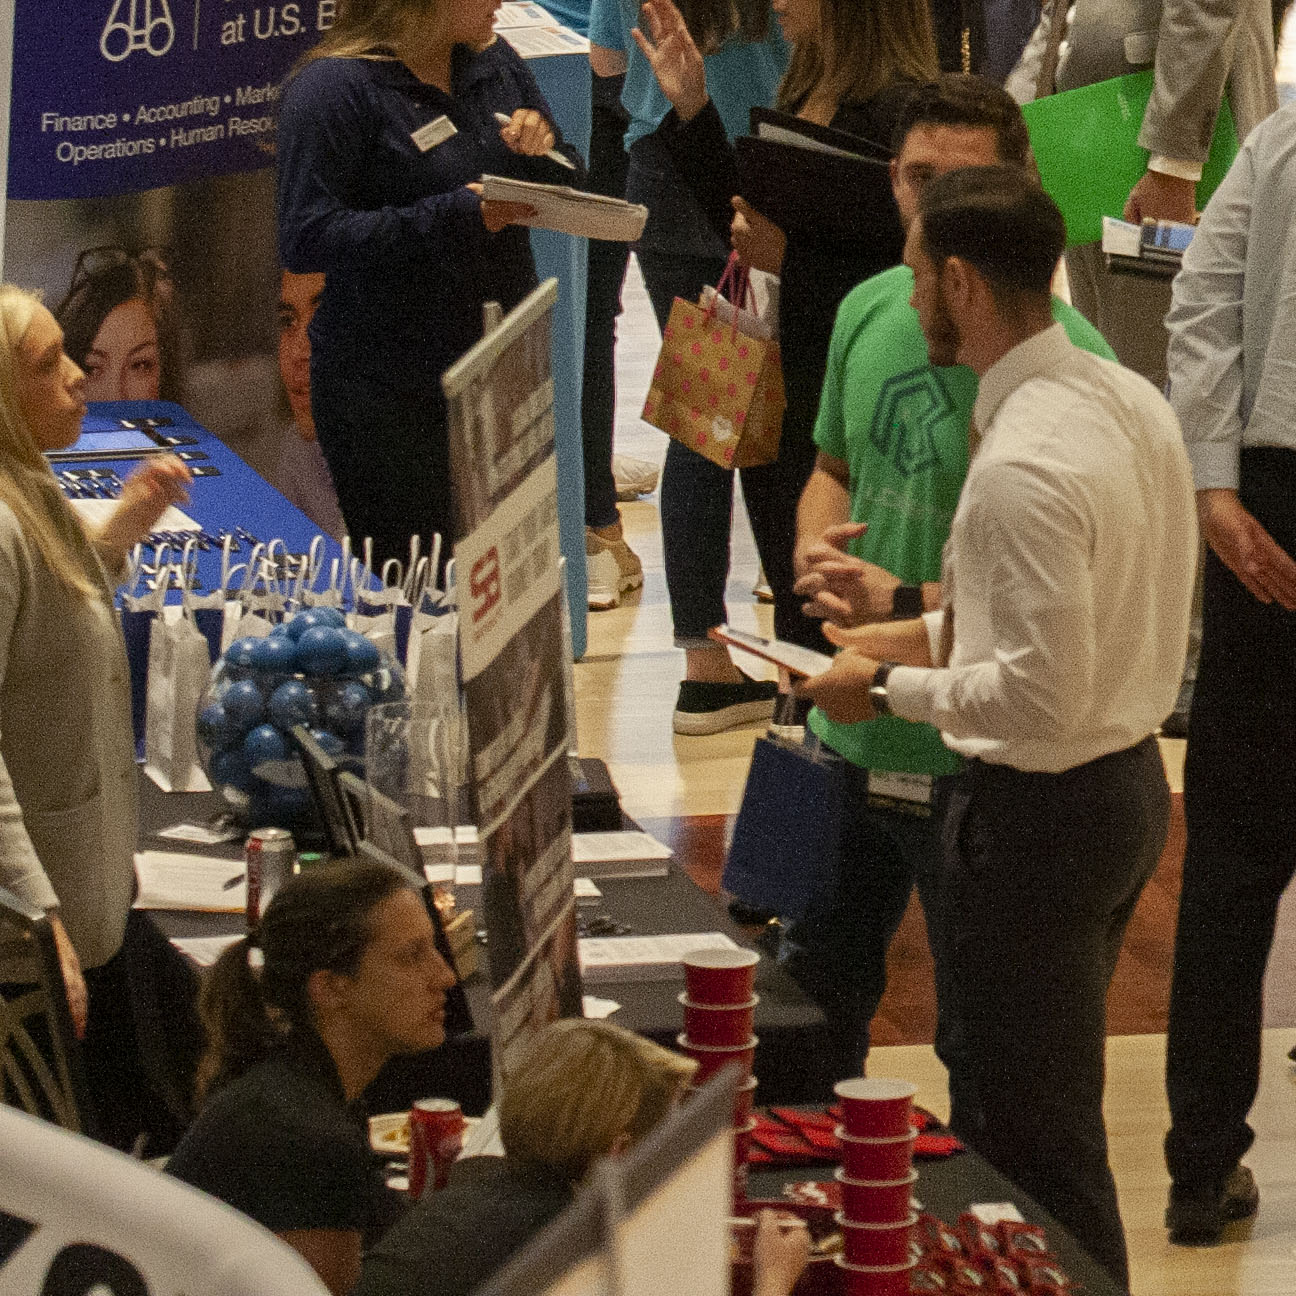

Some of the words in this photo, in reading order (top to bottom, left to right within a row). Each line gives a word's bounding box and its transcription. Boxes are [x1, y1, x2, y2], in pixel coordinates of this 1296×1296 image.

[221, 13, 247, 45] at
[253, 4, 306, 40] U.S.
[41, 112, 118, 133] Finance
[135, 96, 220, 125] Accounting
[235, 83, 280, 107] Mark
[56, 137, 155, 165] Operations
[170, 123, 224, 148] Human
[228, 116, 278, 138] Reso
